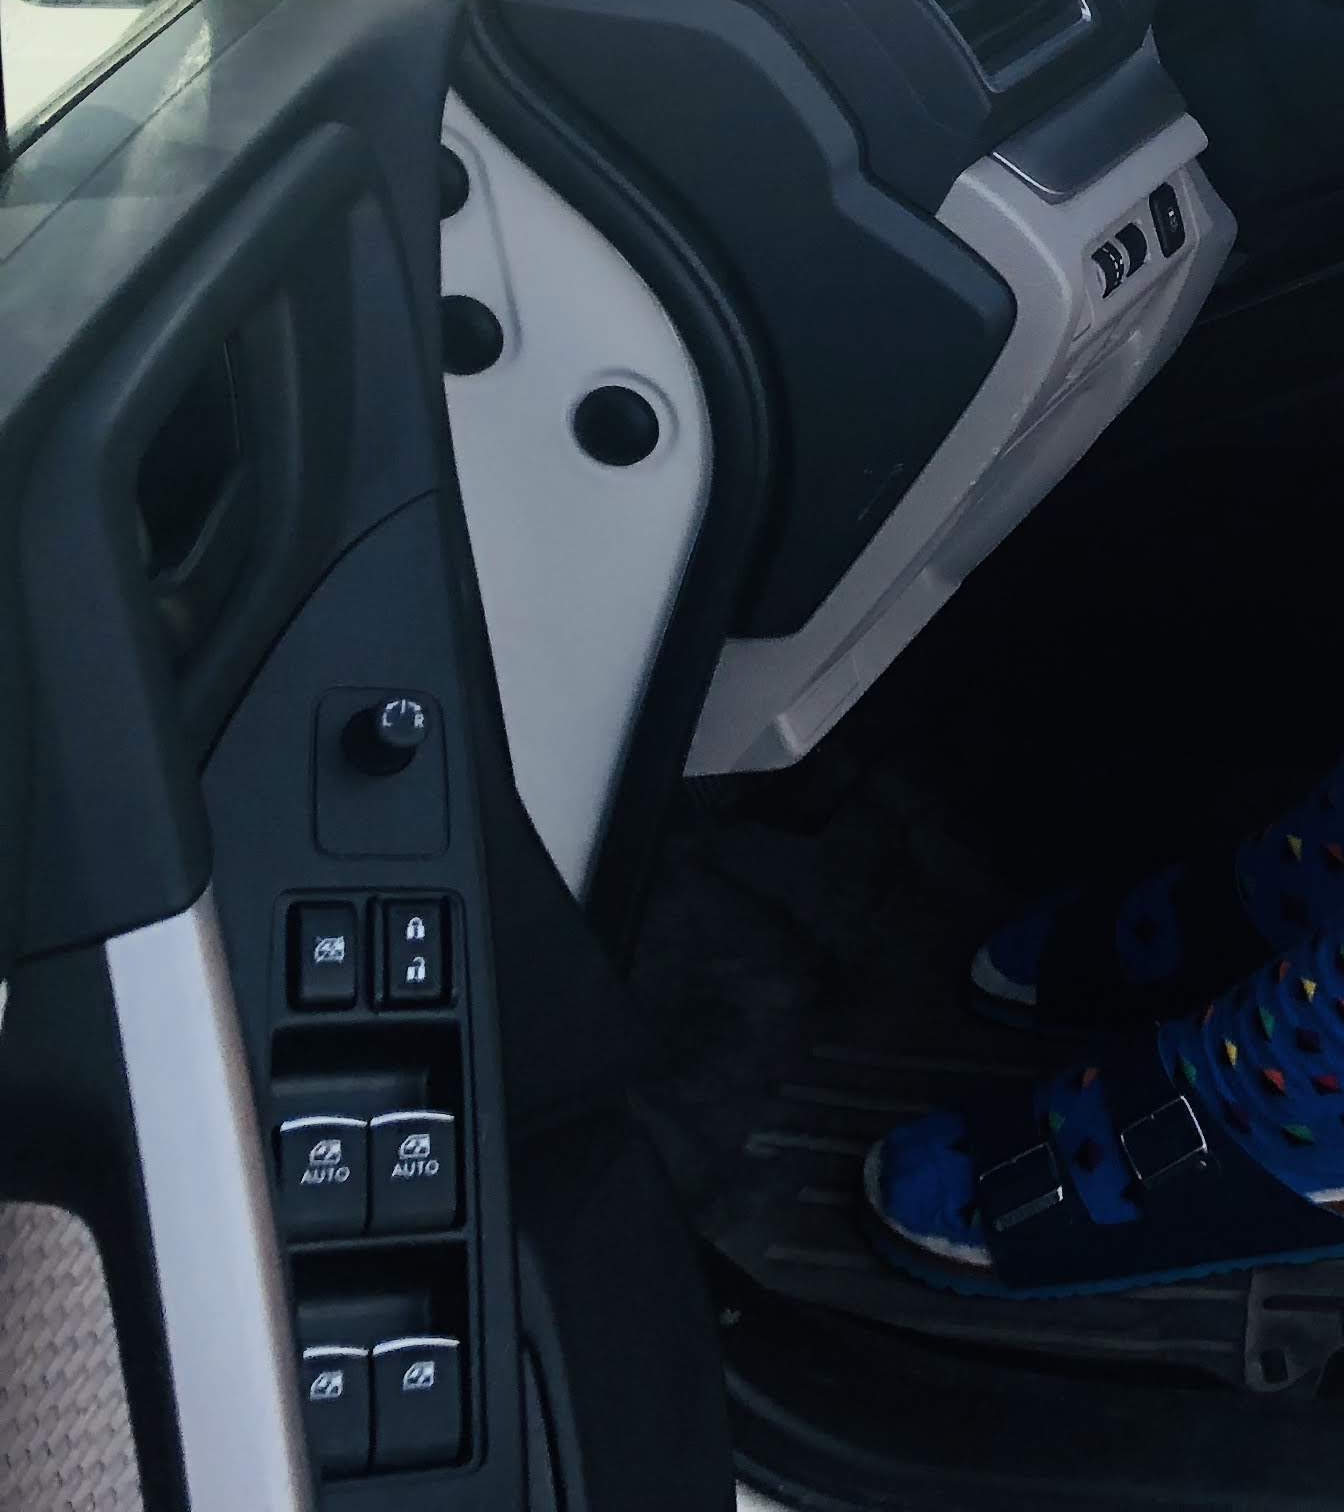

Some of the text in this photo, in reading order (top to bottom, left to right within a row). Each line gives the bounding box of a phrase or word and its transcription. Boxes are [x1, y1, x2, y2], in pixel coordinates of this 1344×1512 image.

[382, 712, 425, 728] L R
[300, 1166, 351, 1185] AUTO
[391, 1159, 440, 1178] AUTO
